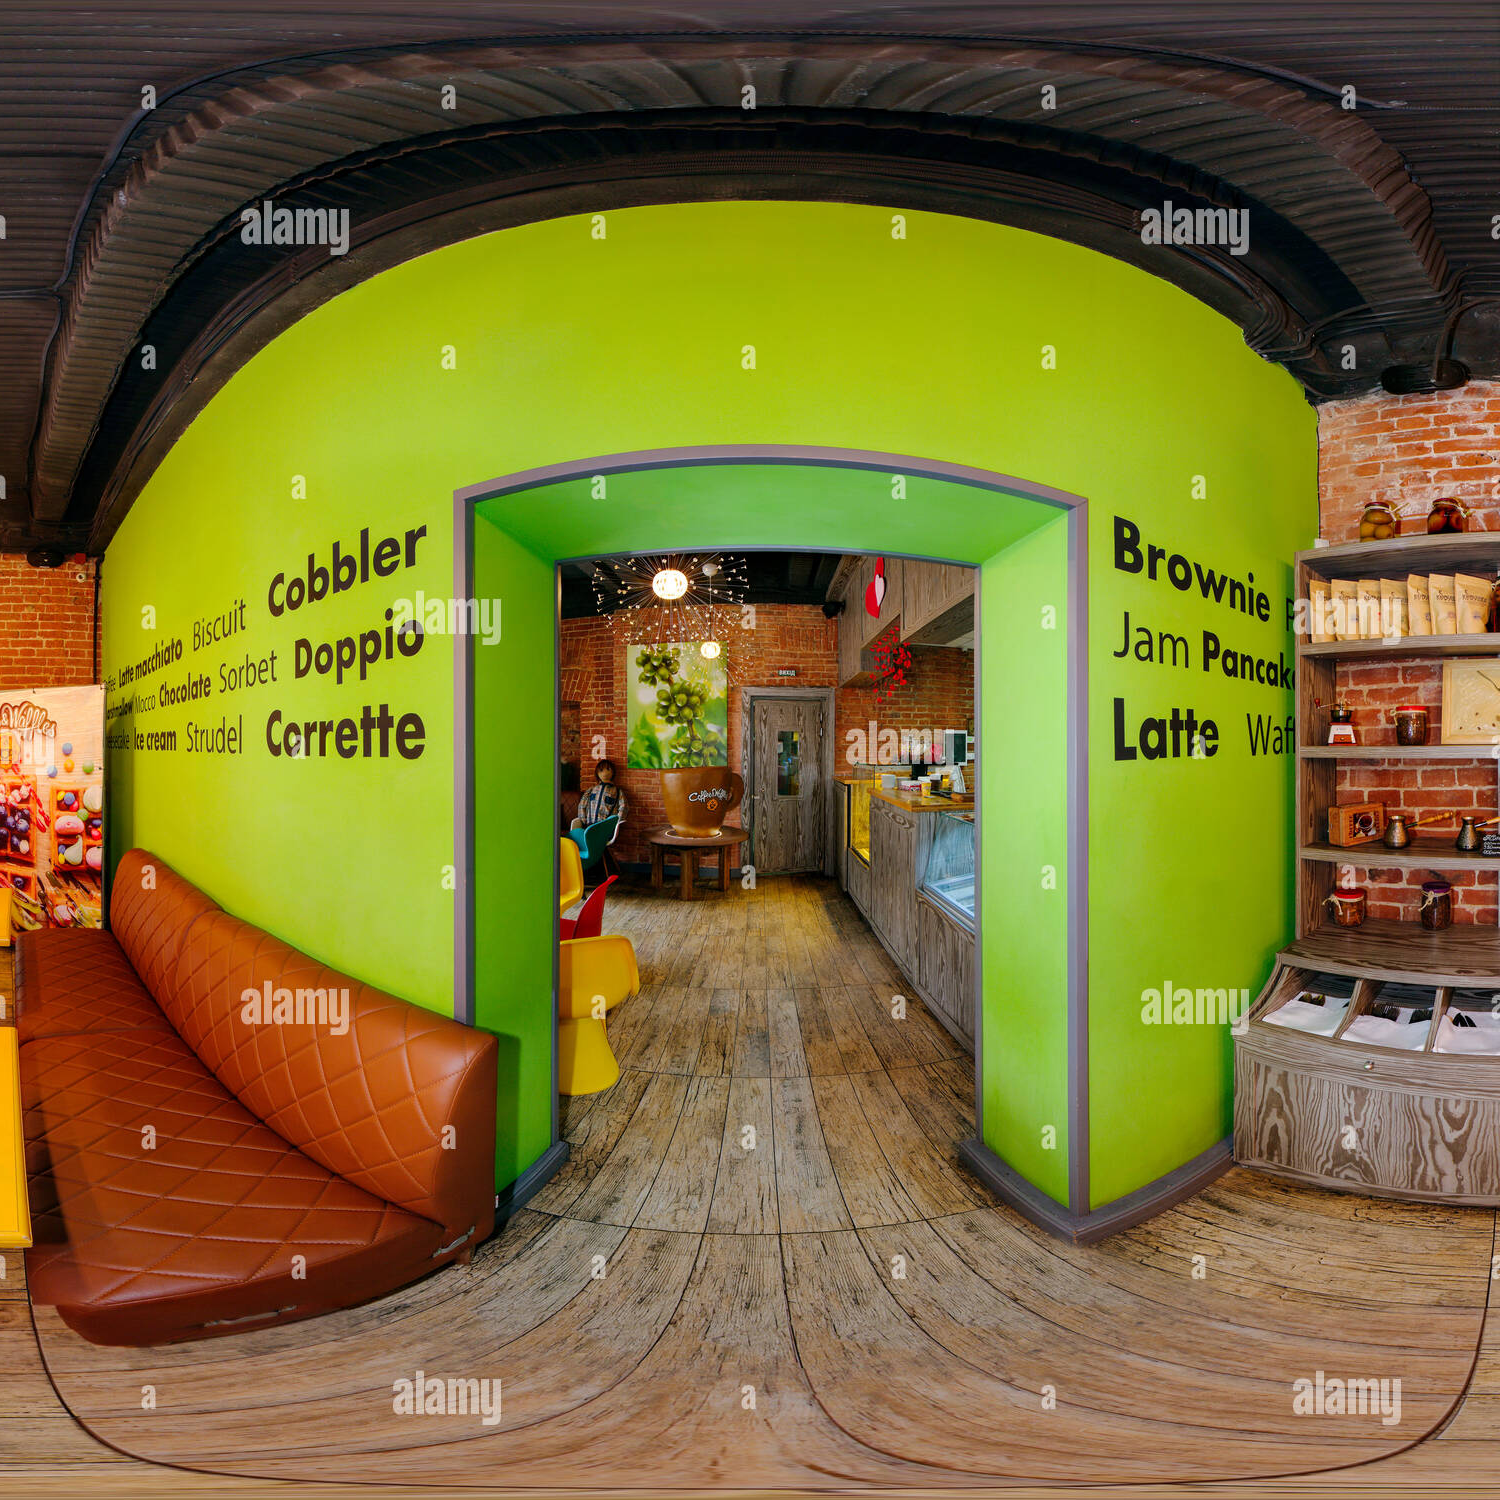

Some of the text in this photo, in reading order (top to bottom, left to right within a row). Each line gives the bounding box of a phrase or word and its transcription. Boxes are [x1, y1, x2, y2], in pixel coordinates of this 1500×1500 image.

[118, 664, 134, 689] Latte
[135, 637, 183, 681] macchiato
[192, 598, 247, 653] Biscuit
[267, 524, 428, 618] Cobbler
[1113, 515, 1271, 623] Brownie
[159, 671, 212, 708] Chocolate
[219, 650, 278, 695] Sorbet
[294, 607, 425, 686] Doppio
[1113, 611, 1296, 691] Jam Pancak
[134, 727, 145, 751] Ice
[146, 729, 178, 752] cream
[186, 714, 243, 755] Strudel
[266, 703, 427, 761] Corrette
[1113, 697, 1220, 762] Latte
